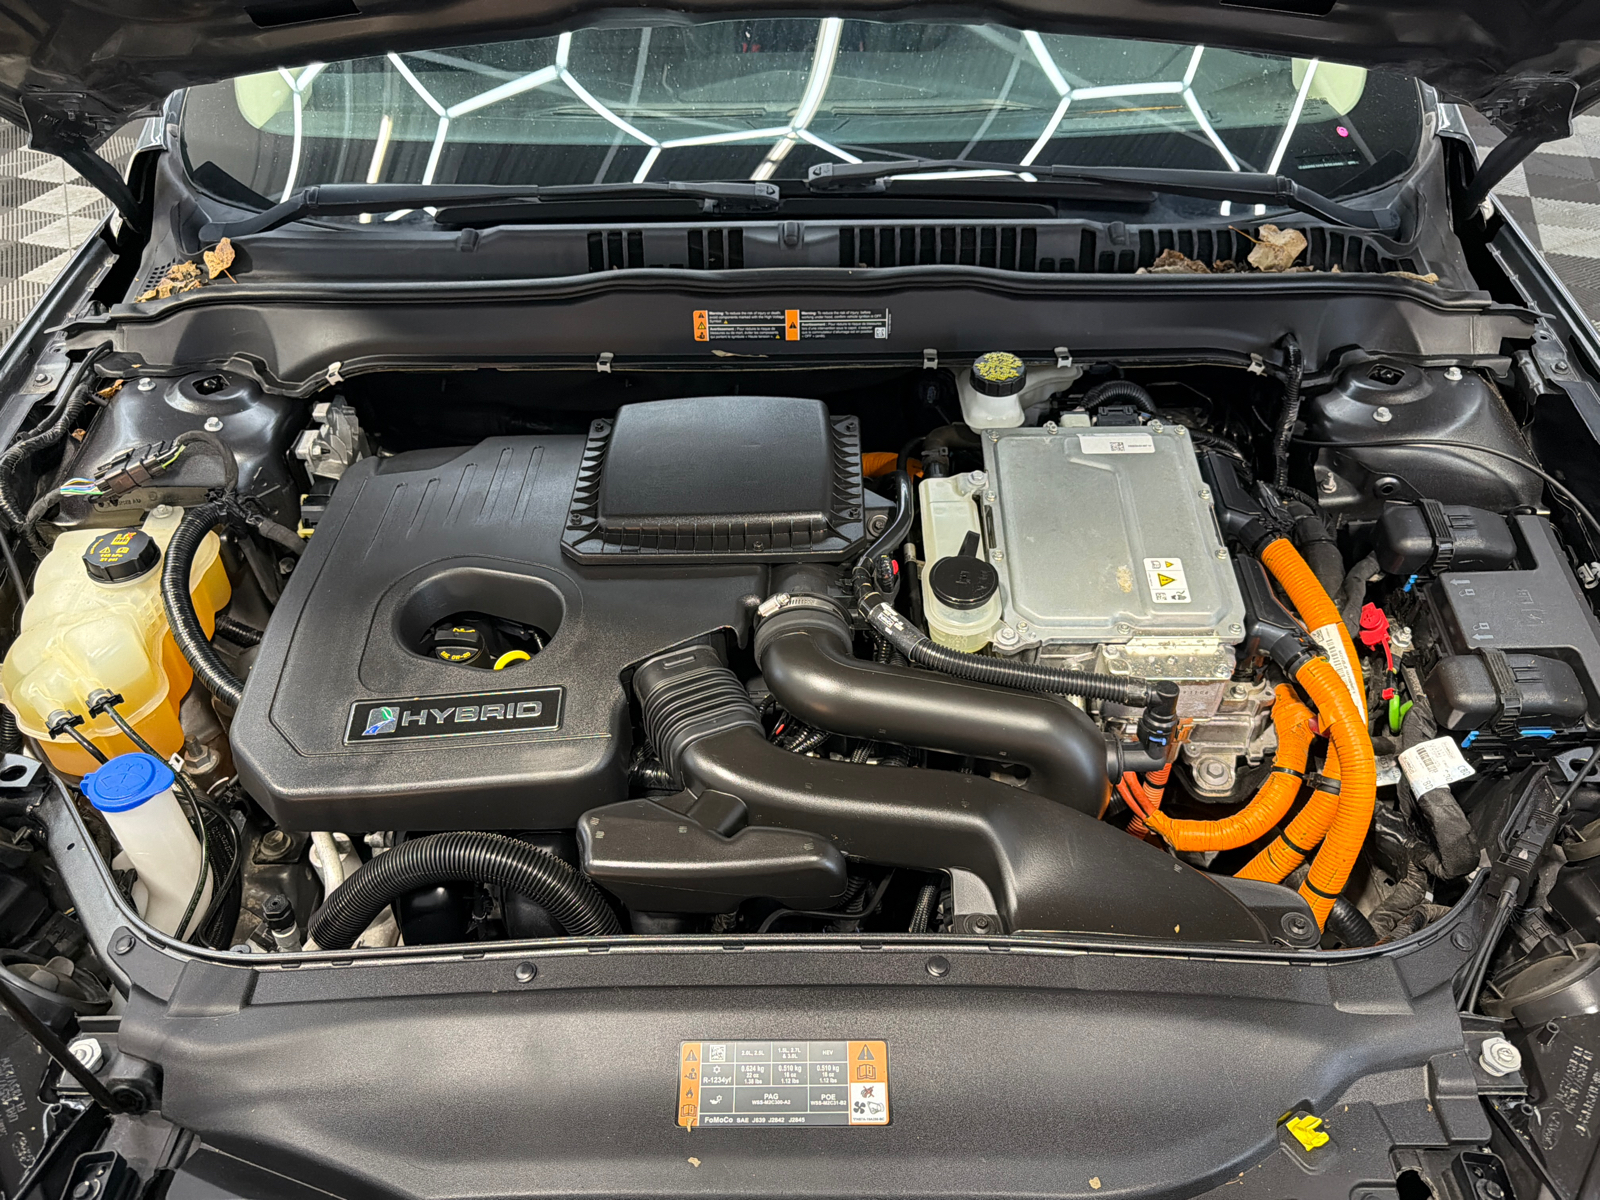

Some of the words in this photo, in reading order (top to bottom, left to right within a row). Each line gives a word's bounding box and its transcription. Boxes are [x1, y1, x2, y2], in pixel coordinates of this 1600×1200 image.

[402, 701, 543, 726] HYBRID
[757, 1065, 764, 1073] kg
[703, 1076, 732, 1084] R-1234yf
